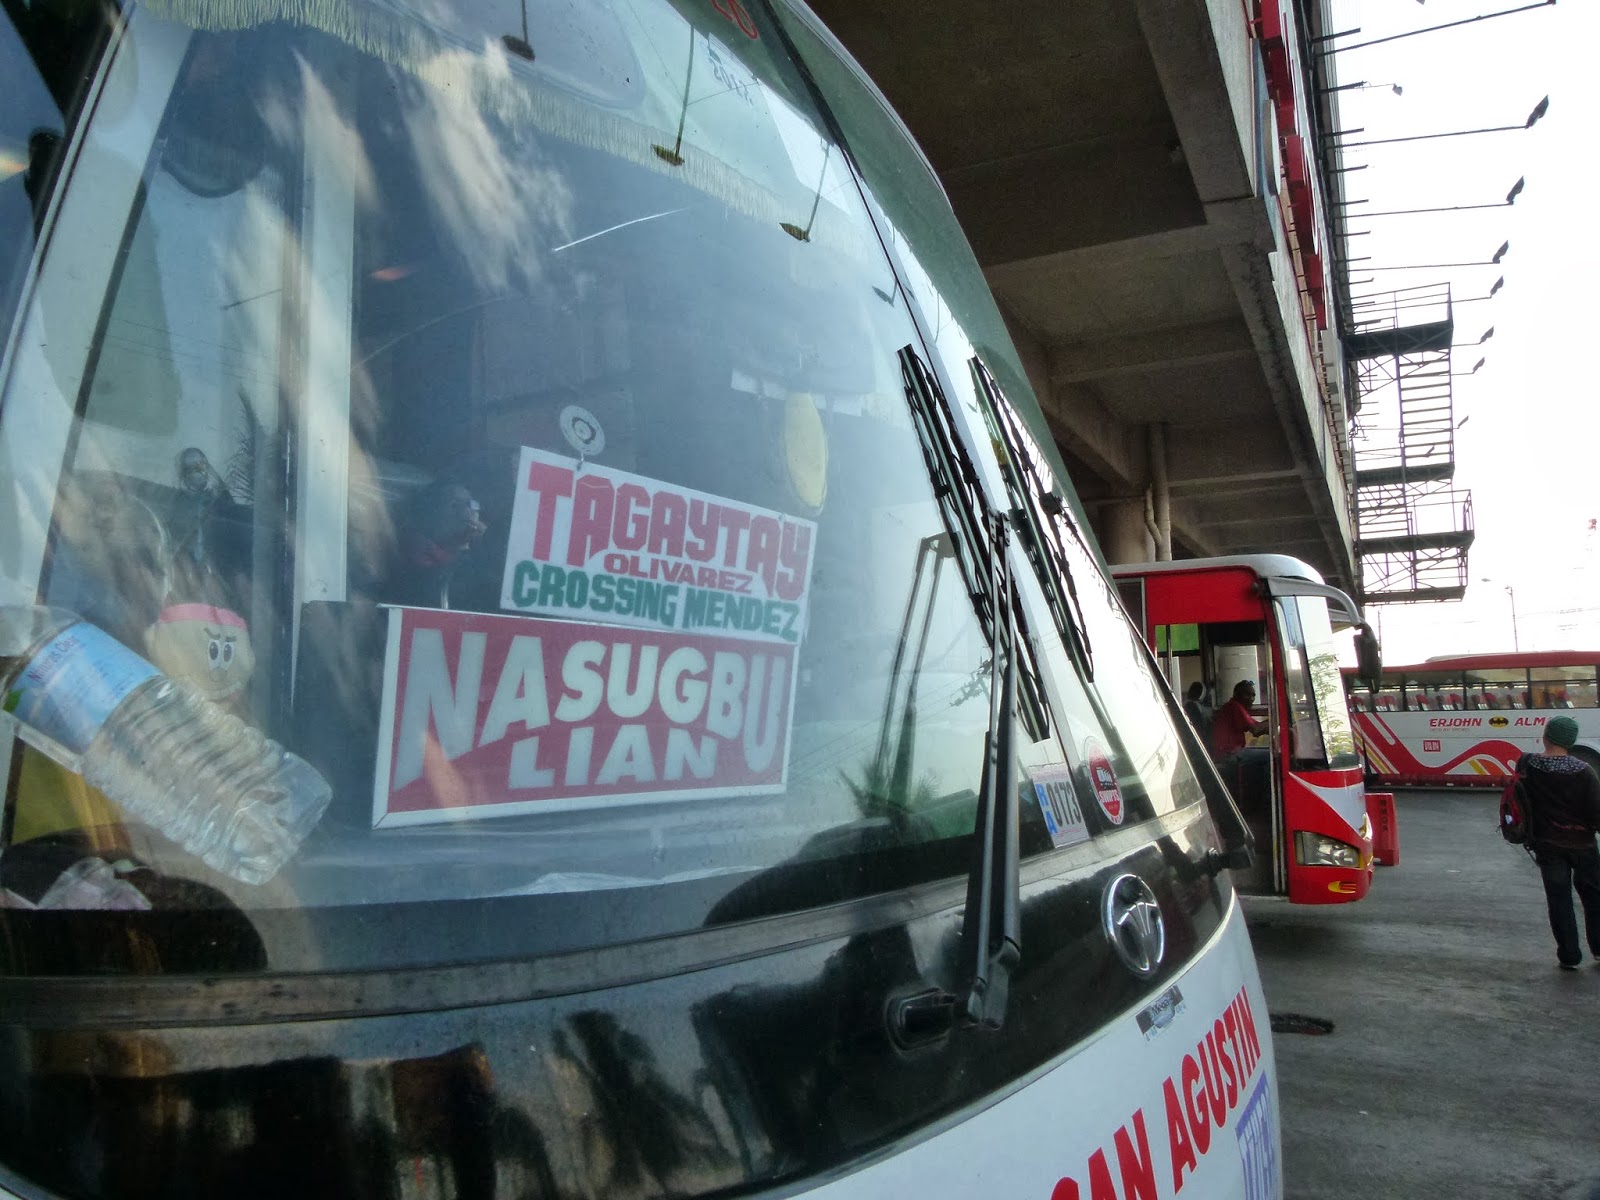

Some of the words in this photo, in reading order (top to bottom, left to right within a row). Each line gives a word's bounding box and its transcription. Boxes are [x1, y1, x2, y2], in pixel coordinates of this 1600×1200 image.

[527, 461, 811, 600] TAGAYTAY
[511, 560, 680, 629] CROSSING
[682, 587, 801, 643] MENDEZ
[603, 553, 753, 594] OLIVAREZ
[394, 628, 786, 791] NASUGBU
[1429, 718, 1482, 727] ERJOHN
[1514, 717, 1552, 726] ALM
[508, 725, 718, 789] LIAN
[1045, 781, 1082, 827] 0173
[1162, 984, 1261, 1196] AGUSTIN
